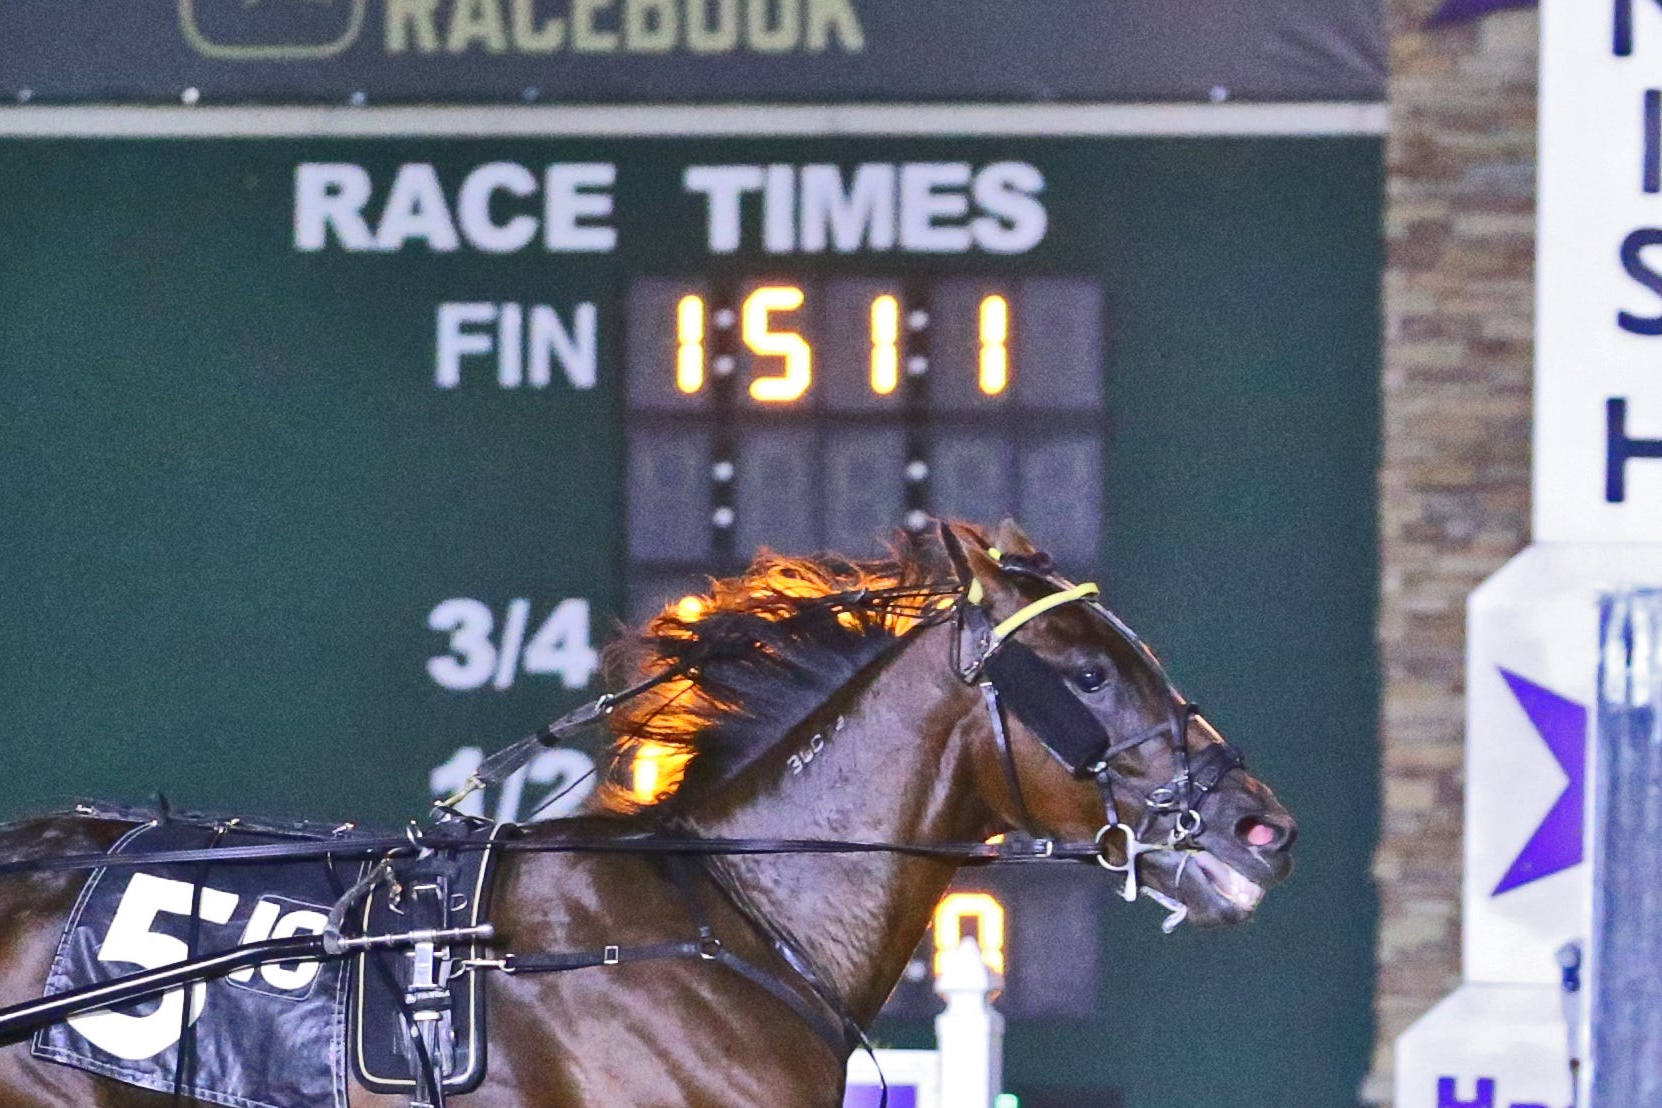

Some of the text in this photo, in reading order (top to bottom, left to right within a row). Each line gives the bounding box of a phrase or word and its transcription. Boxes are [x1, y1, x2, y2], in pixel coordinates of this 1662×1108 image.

[293, 160, 1050, 256] RACE TIMES
[435, 302, 598, 389] FIN
[426, 597, 598, 691] 3/4
[66, 871, 330, 1060] 5 10
